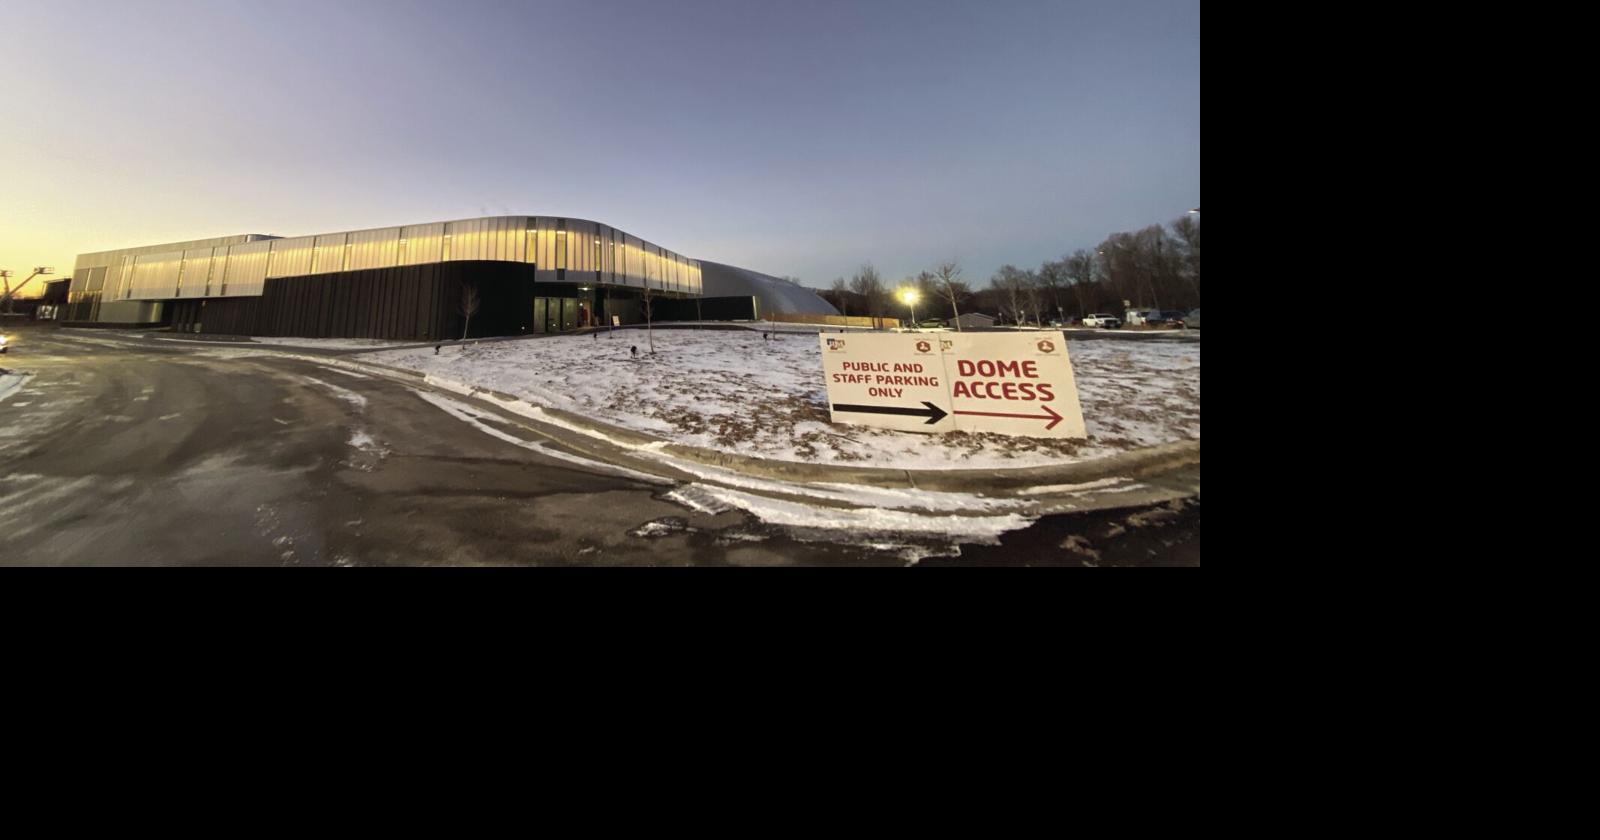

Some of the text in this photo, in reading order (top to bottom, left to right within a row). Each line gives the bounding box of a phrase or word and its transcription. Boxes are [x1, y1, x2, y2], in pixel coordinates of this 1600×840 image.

[842, 361, 923, 374] PUBLIC AND
[957, 359, 1039, 379] DOME
[832, 373, 939, 387] STAFF PARKING
[868, 387, 904, 398] ONLY
[953, 381, 1056, 402] ACCESS
